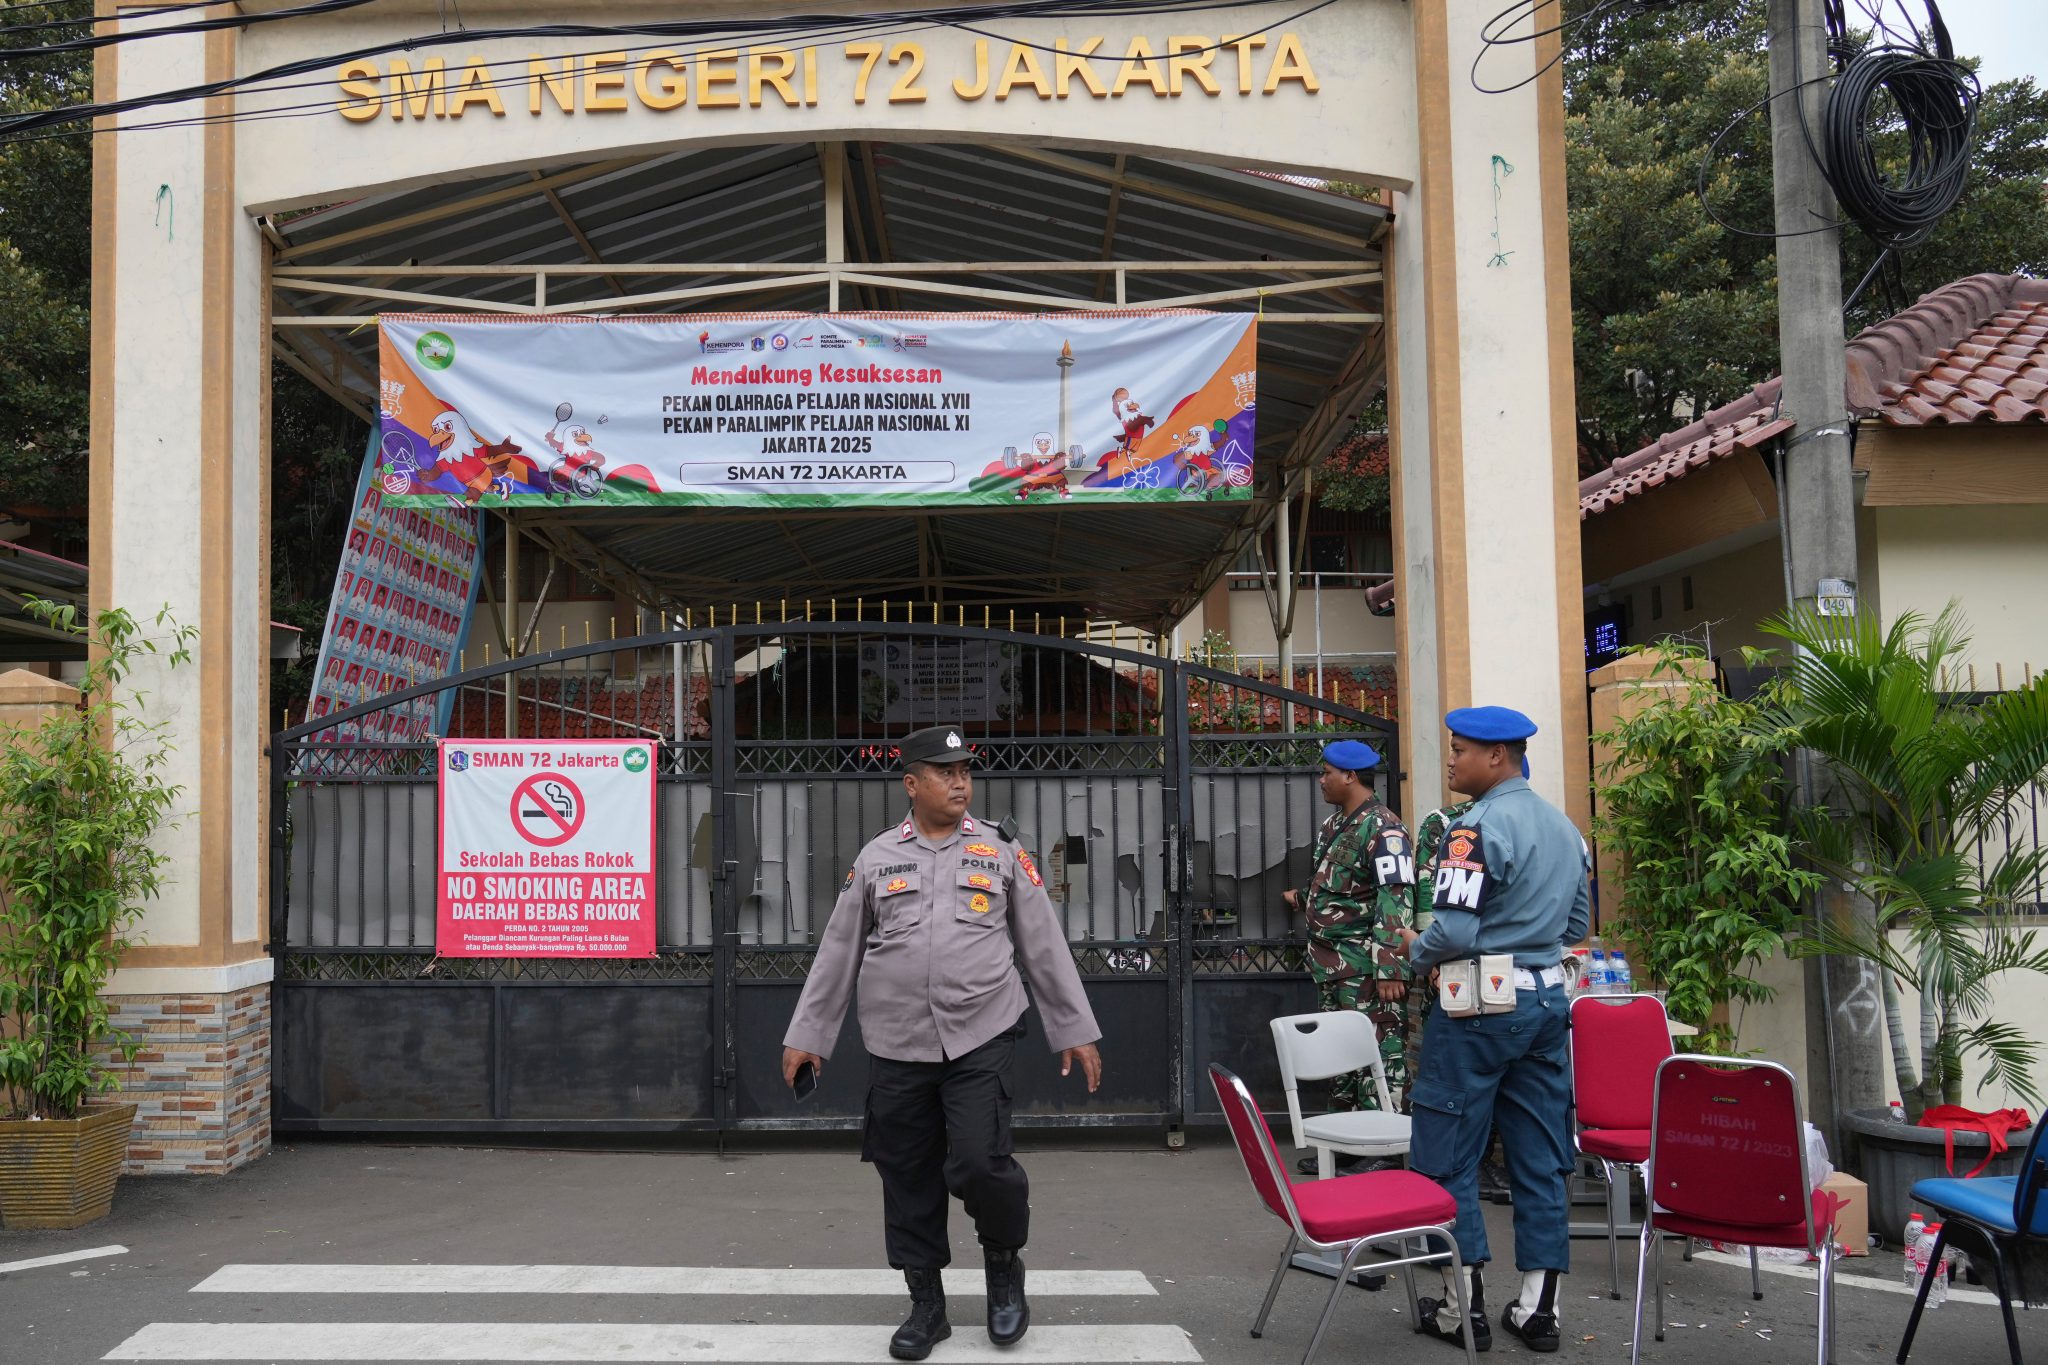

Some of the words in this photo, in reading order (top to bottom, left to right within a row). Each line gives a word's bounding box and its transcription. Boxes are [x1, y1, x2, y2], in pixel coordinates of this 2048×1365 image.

[337, 56, 506, 122] SMA
[528, 45, 819, 115] NEGERI
[844, 42, 928, 104] 72
[951, 32, 1320, 101] JAKARTA
[691, 365, 812, 387] Mendukung
[819, 363, 942, 385] Kesuksesan
[662, 395, 712, 412] PEKAN
[715, 393, 793, 412] OLAHRAGA
[796, 393, 860, 411] PELAJAR
[863, 393, 937, 410] NASIONAL
[940, 393, 970, 410] XVII
[663, 416, 713, 434] PEKAN
[716, 415, 806, 433] PARALIMPIK
[810, 414, 874, 432] PELAJAR
[877, 414, 951, 432] NASIONAL
[954, 414, 970, 431] XI
[761, 436, 827, 454] JAKARTA
[830, 436, 872, 453] 2025
[727, 466, 785, 480] SMAN
[790, 465, 812, 480] 72
[817, 465, 907, 480] JAKARTA
[472, 752, 524, 767] SMAN
[530, 752, 551, 767] 72
[557, 752, 619, 767] Jakarta
[460, 851, 524, 867] Sekolah
[529, 851, 579, 867] Bebas
[585, 851, 634, 868] Rokok
[961, 858, 1001, 872] POLRI
[878, 862, 918, 877] A.PRAMONO
[1374, 854, 1416, 886] PM
[447, 876, 476, 899] NO
[484, 876, 583, 900] SMOKING
[590, 877, 646, 900] AREA
[1433, 867, 1485, 909] PM
[452, 902, 519, 920] DAERAH
[524, 902, 578, 920] BEBAS
[584, 903, 640, 920] ROKOK
[504, 924, 527, 932] PERDA
[528, 924, 540, 932] NO.
[463, 934, 497, 942] Pelanggar
[529, 934, 561, 942] Kurungan
[562, 934, 583, 942] Paling
[504, 943, 575, 952] Sebanyak-banyaknya
[576, 943, 587, 952] Rp.
[588, 943, 627, 951] 50.000.000
[1701, 1112, 1757, 1132] HIBAH
[1665, 1129, 1715, 1147] SMAN
[1720, 1136, 1740, 1151] 72
[1743, 1138, 1750, 1152] /
[1754, 1141, 1792, 1157] 2023
